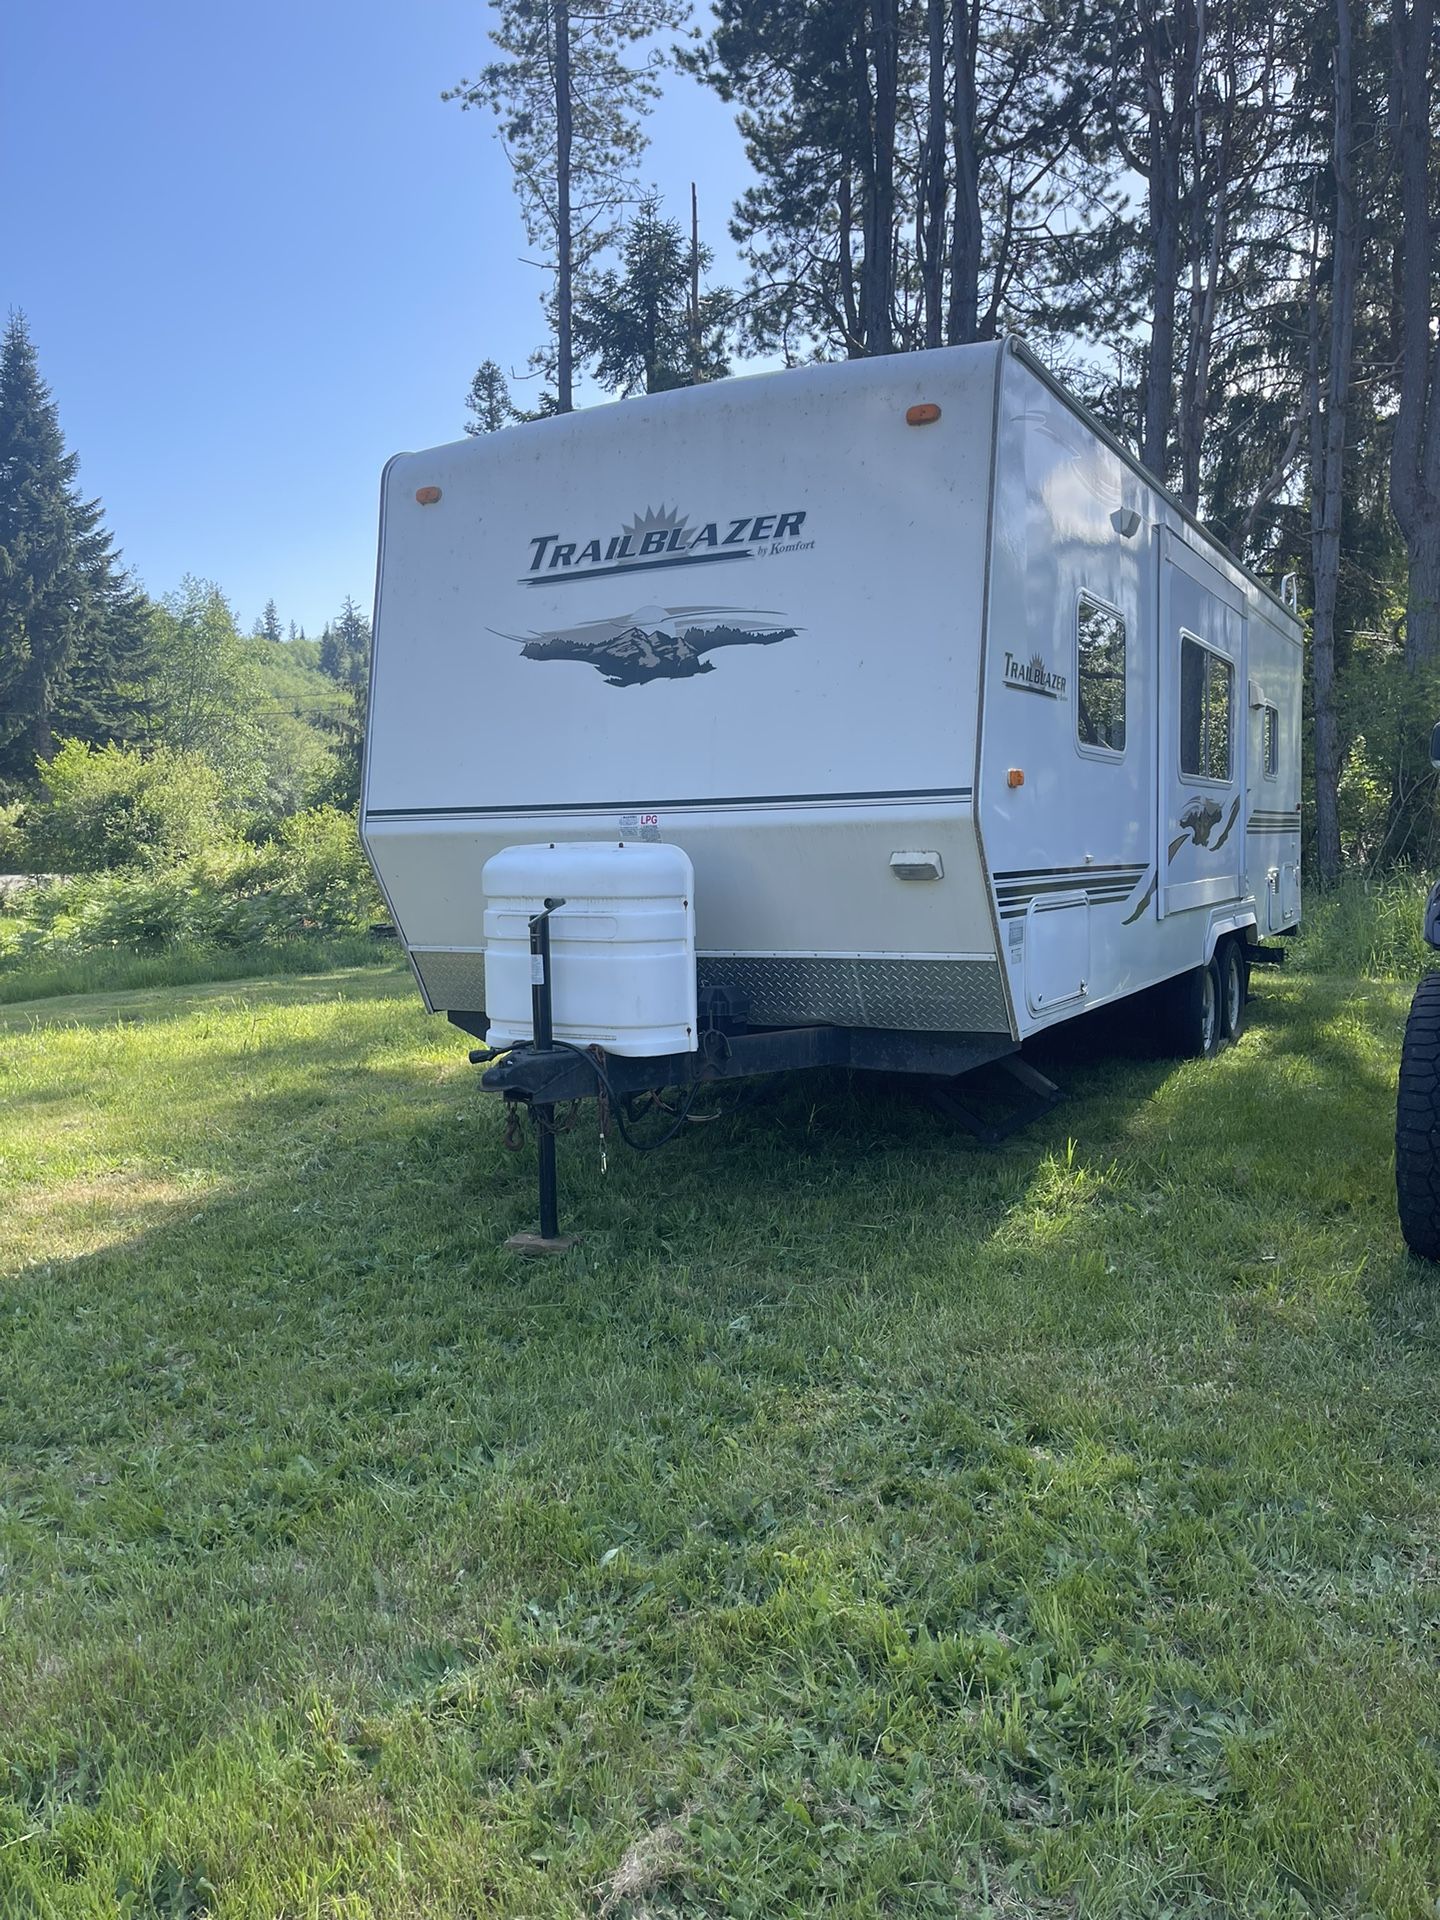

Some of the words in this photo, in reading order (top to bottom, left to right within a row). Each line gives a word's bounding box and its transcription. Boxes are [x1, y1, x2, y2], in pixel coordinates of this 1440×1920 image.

[529, 511, 807, 571] TRAILBLAZER
[757, 545, 768, 558] by
[769, 540, 816, 556] Komfort
[1004, 651, 1067, 693] TRAILBLAZER
[640, 814, 658, 825] LPG
